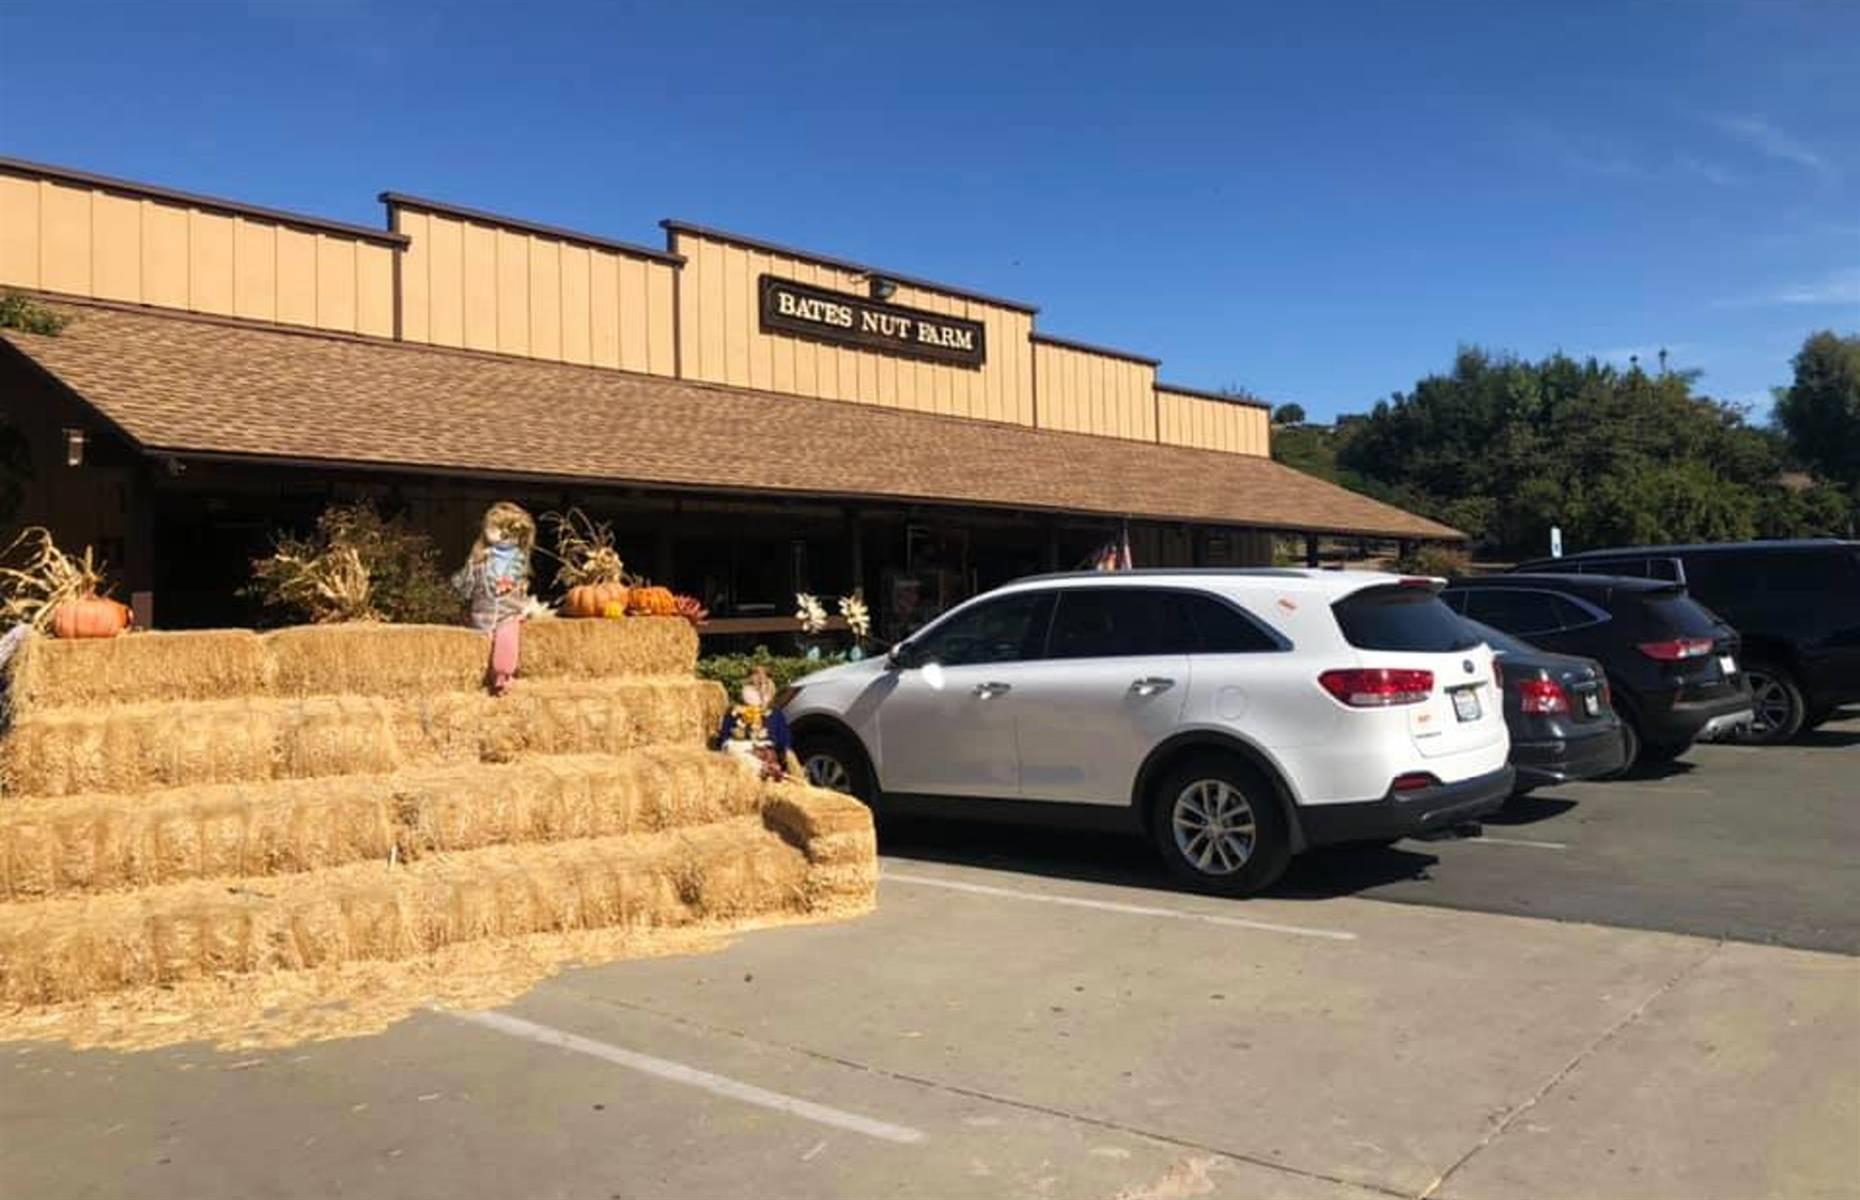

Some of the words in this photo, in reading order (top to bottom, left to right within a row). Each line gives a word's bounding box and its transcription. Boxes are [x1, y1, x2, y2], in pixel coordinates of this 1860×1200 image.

[778, 293, 852, 327] BATES
[862, 311, 911, 337] NUT
[918, 322, 973, 349] FARM
